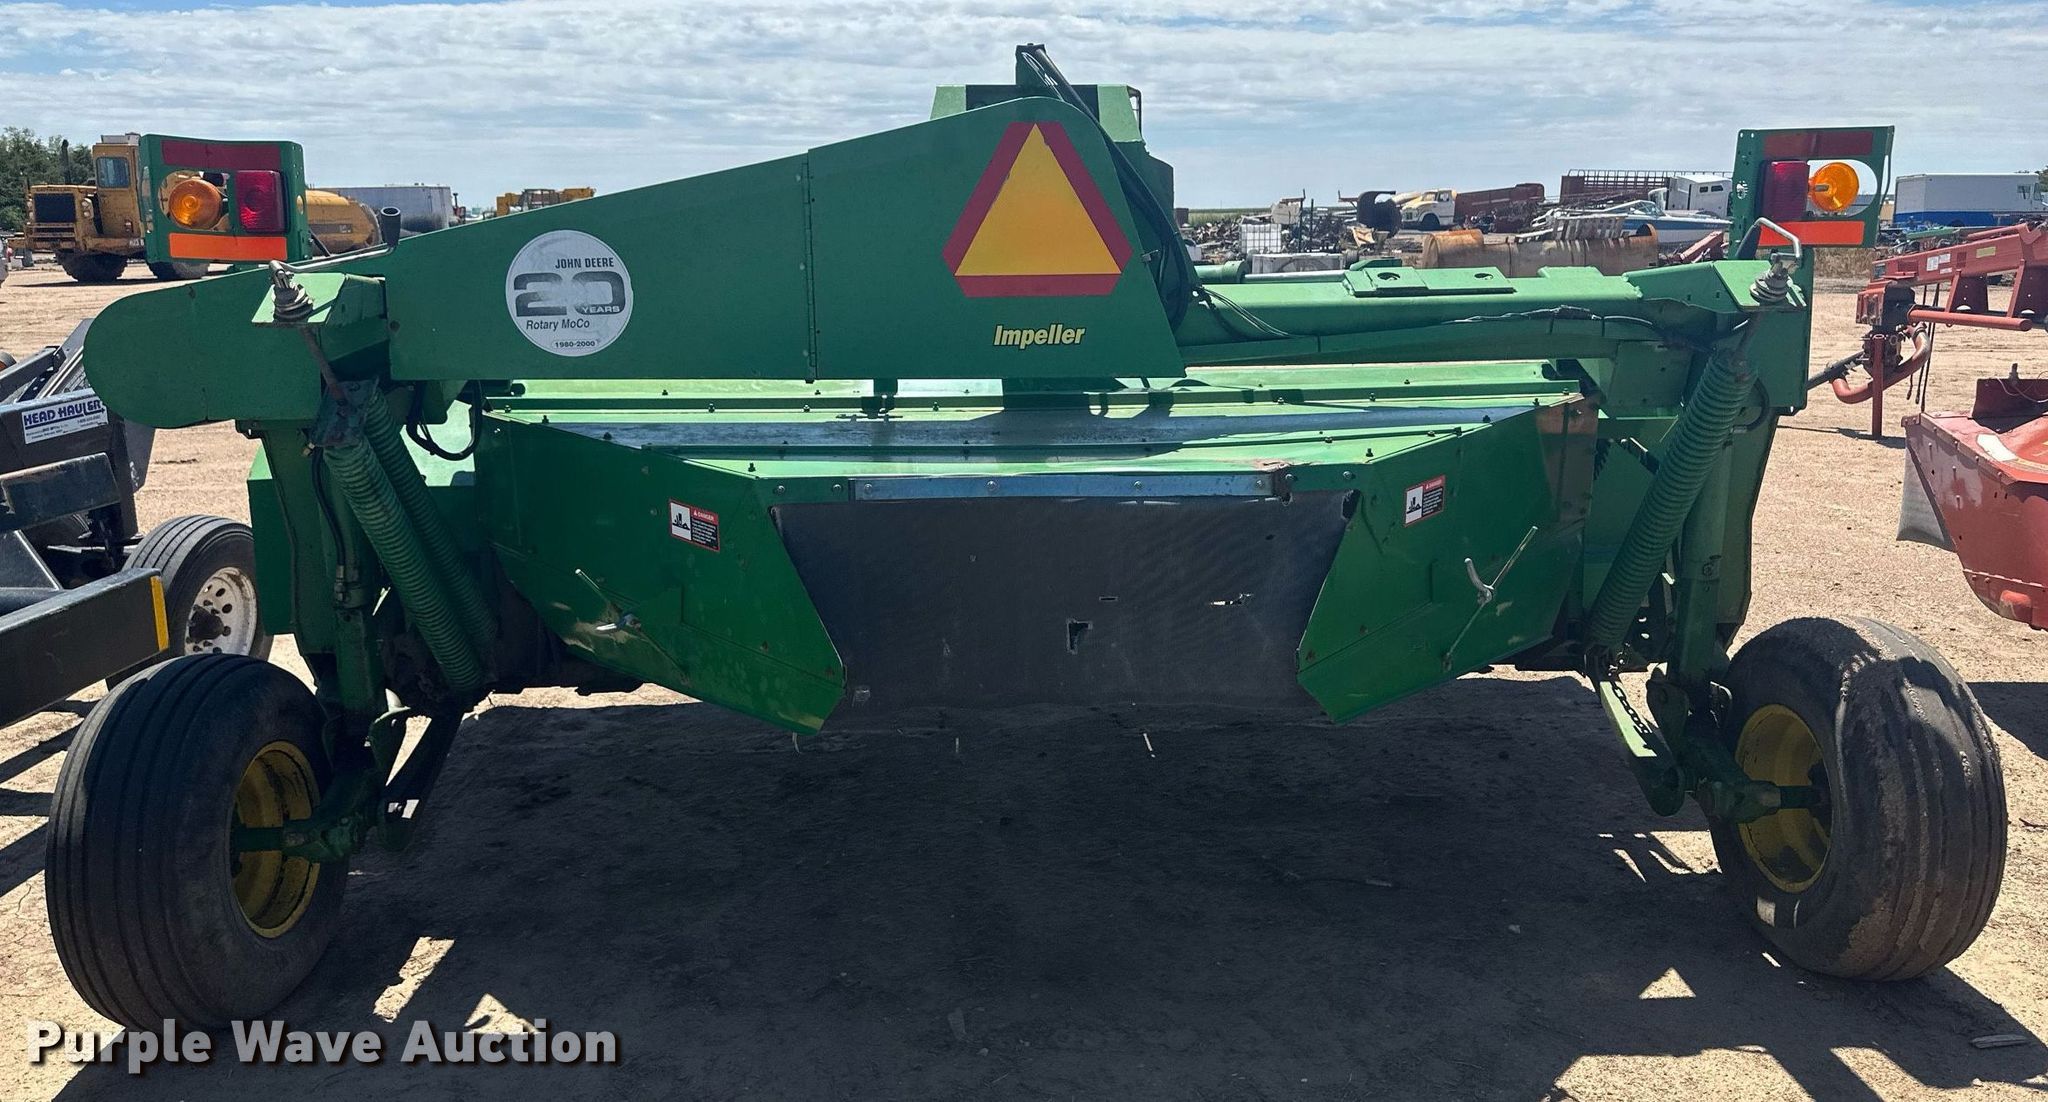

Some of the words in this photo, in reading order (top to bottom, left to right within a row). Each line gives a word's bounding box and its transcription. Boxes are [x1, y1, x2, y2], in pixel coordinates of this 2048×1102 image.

[555, 258, 581, 269] JOHN
[585, 257, 614, 268] DEERE
[514, 271, 626, 317] 20
[582, 305, 620, 313] YEARS
[526, 319, 559, 331] Rotary
[561, 318, 590, 329] MoCo
[993, 324, 1086, 349] Impeller
[555, 340, 596, 348] 1980-2000
[23, 409, 56, 426] HEAD
[58, 400, 102, 416] HAULER
